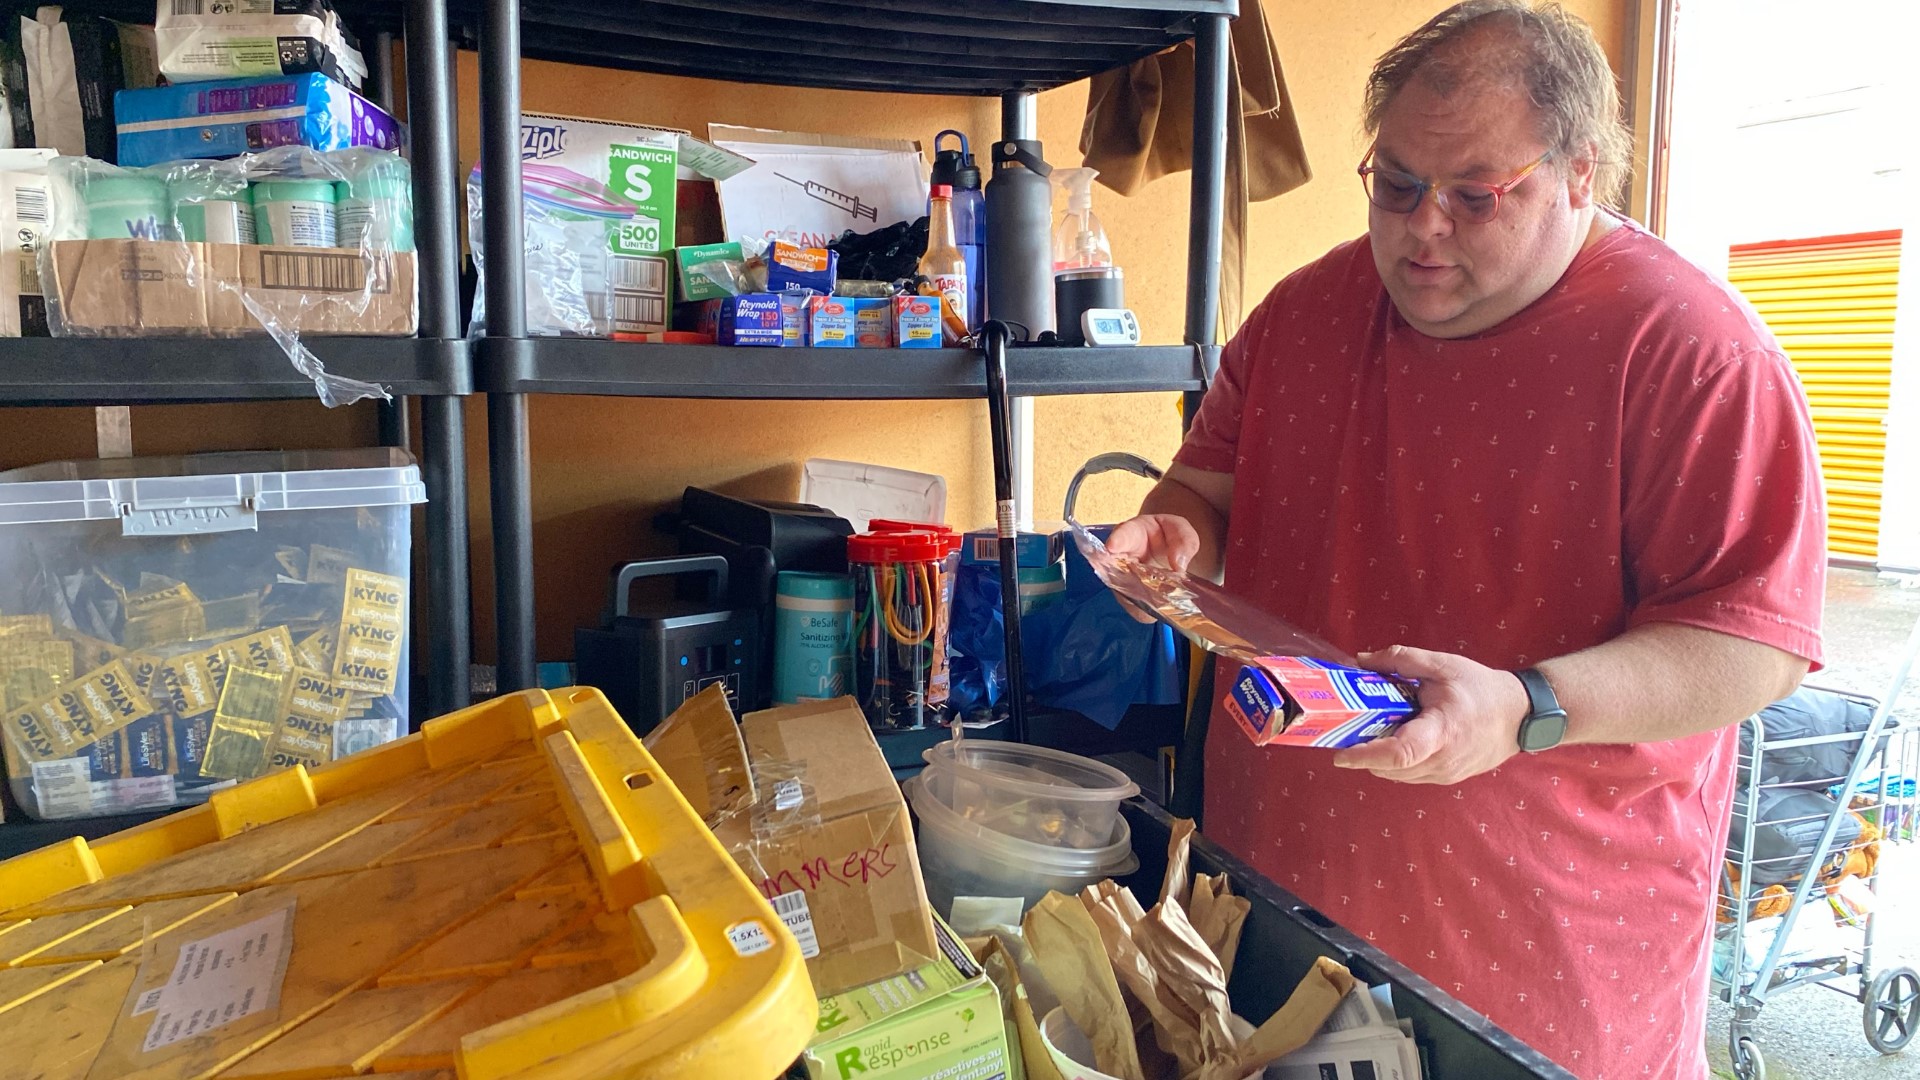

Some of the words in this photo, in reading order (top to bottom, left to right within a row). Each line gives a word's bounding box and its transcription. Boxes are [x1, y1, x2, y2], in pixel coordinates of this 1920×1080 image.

[608, 147, 673, 164] SANDWICH
[624, 164, 652, 201] S
[621, 225, 657, 242] 500
[776, 248, 819, 263] SANDWICH
[785, 281, 801, 291] 150
[736, 308, 760, 320] Wrap
[760, 311, 778, 321] 150
[739, 299, 778, 310] Reynolds
[354, 587, 400, 605] KYNG
[348, 624, 396, 641] KYNG
[810, 617, 839, 628] BeSafe
[800, 631, 841, 643] Sanitizing
[342, 662, 389, 681] KYNG
[162, 667, 188, 712] KYNG
[184, 660, 206, 706] LifeStyles
[298, 677, 346, 699] KYNG
[1240, 681, 1255, 705] Wrap
[1356, 678, 1405, 702] Wrap
[82, 682, 115, 725] LifeStyles
[100, 673, 136, 717] KYNG
[1244, 677, 1270, 714] Reynolds
[59, 693, 94, 737] KYNG
[292, 696, 340, 716] LifeStyles
[42, 702, 74, 746] LifeStyles
[286, 716, 333, 736] KYNG
[18, 714, 54, 757] KYNG
[139, 731, 150, 766] LifeStyles
[987, 1047, 1003, 1061] au
